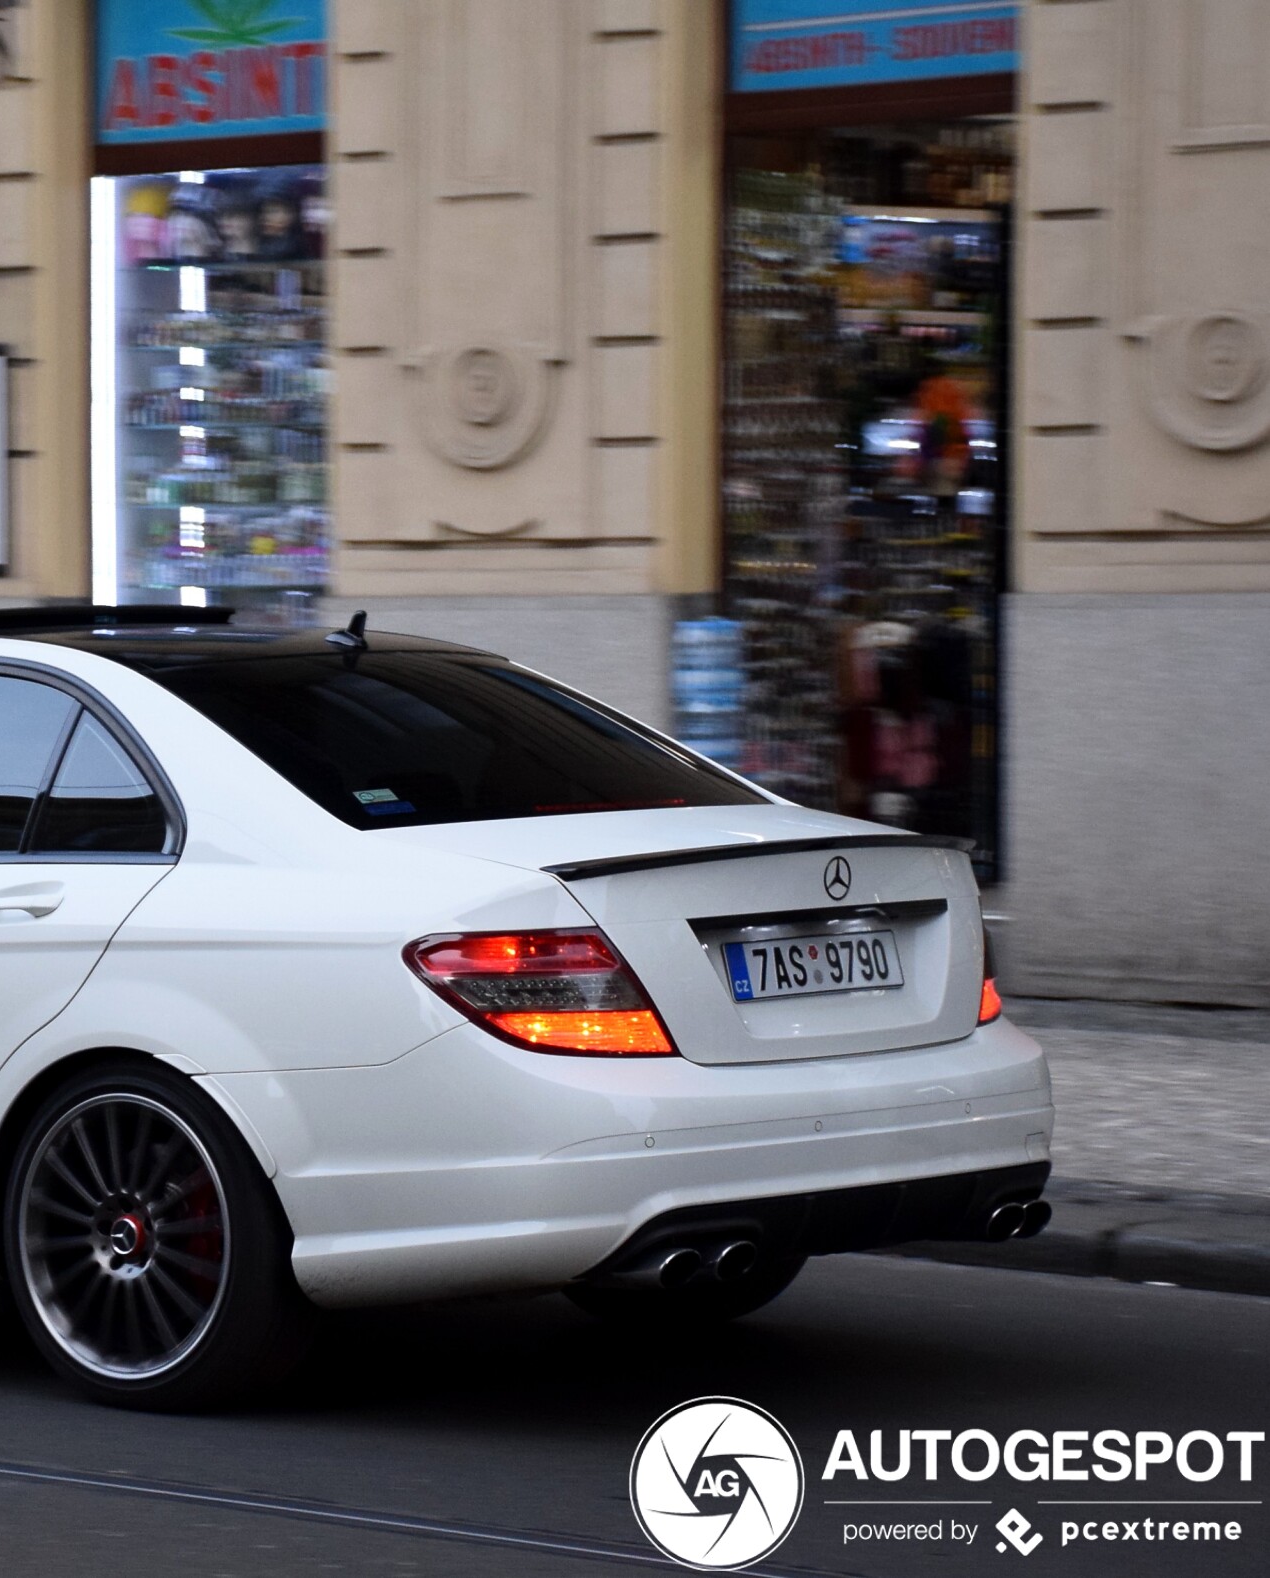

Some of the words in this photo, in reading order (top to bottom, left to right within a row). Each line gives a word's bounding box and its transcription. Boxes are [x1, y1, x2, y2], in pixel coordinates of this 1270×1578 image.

[752, 945, 808, 991] 7AS
[825, 938, 889, 984] 9790
[735, 980, 750, 993] CZ
